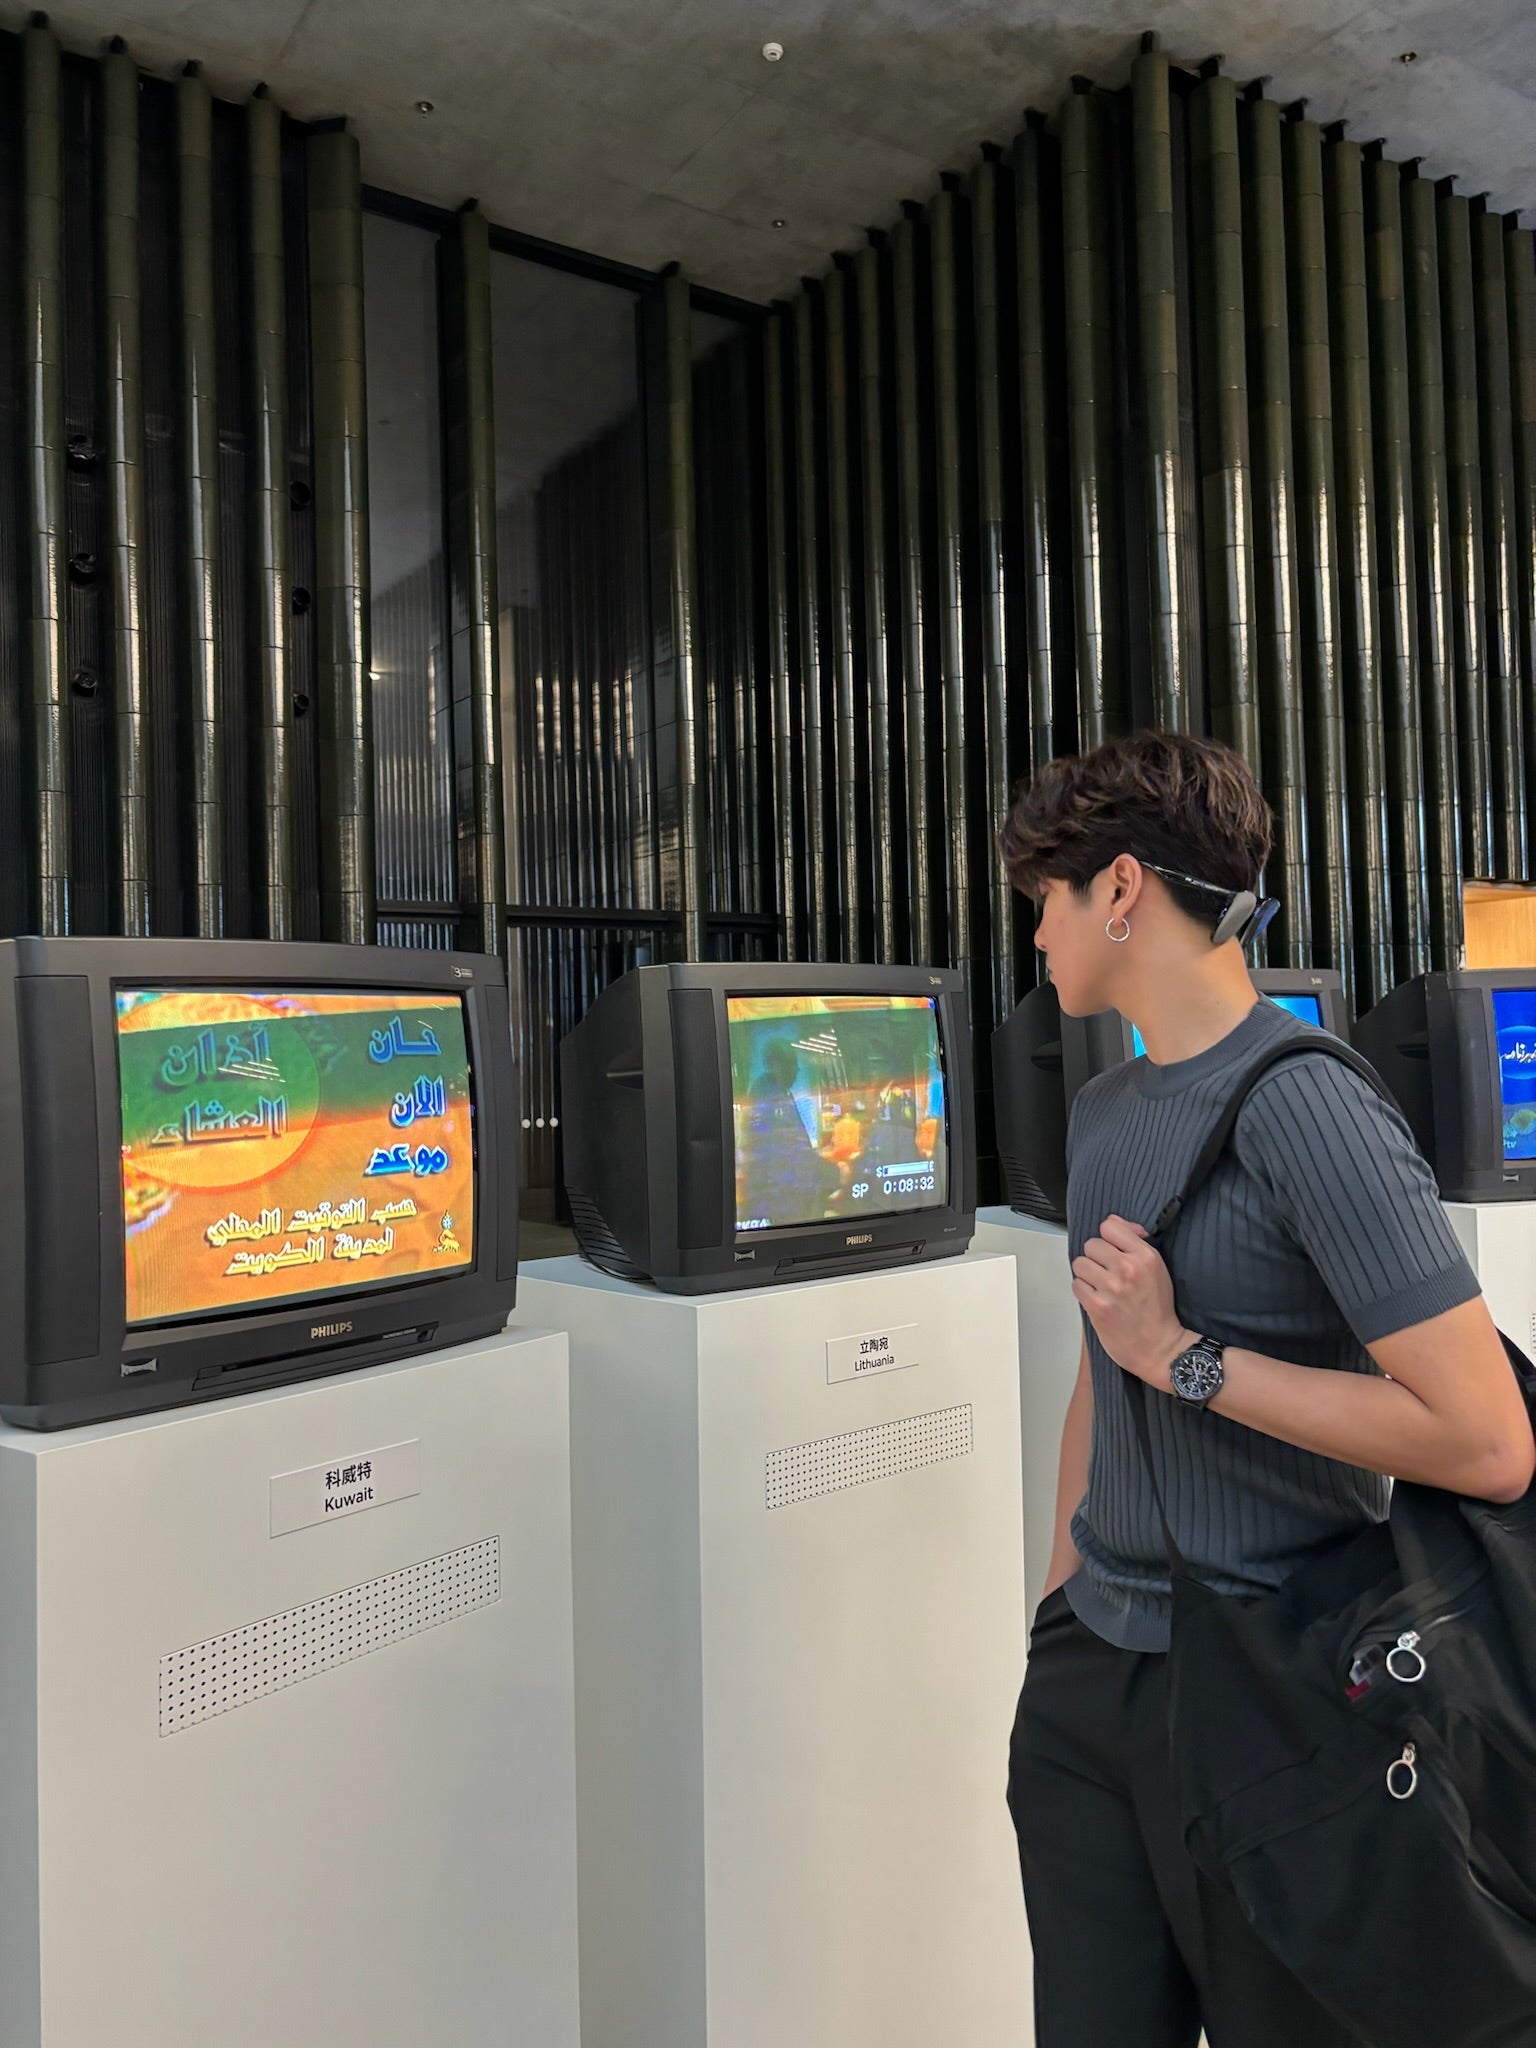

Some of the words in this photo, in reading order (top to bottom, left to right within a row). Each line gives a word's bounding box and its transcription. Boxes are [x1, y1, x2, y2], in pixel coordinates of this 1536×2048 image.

[369, 1016, 442, 1063] حان
[392, 1074, 446, 1127] الان
[152, 1094, 287, 1145] العشاء
[365, 1143, 448, 1176] موعد
[852, 1182, 869, 1199] SP
[883, 1175, 935, 1195] 0:08:32
[206, 1207, 282, 1247] المحلي
[287, 1196, 367, 1233] التوقيت
[370, 1198, 418, 1225] حسب
[225, 1235, 326, 1275] الكويت
[333, 1226, 395, 1260] لمدينة
[846, 1234, 873, 1246] PHILIPS
[310, 1321, 353, 1340] PHILIPS
[859, 1336, 889, 1355] 立陶宛
[854, 1354, 895, 1372] Lithuania
[325, 1460, 373, 1490] 科威特
[325, 1487, 374, 1513] Kuwait
